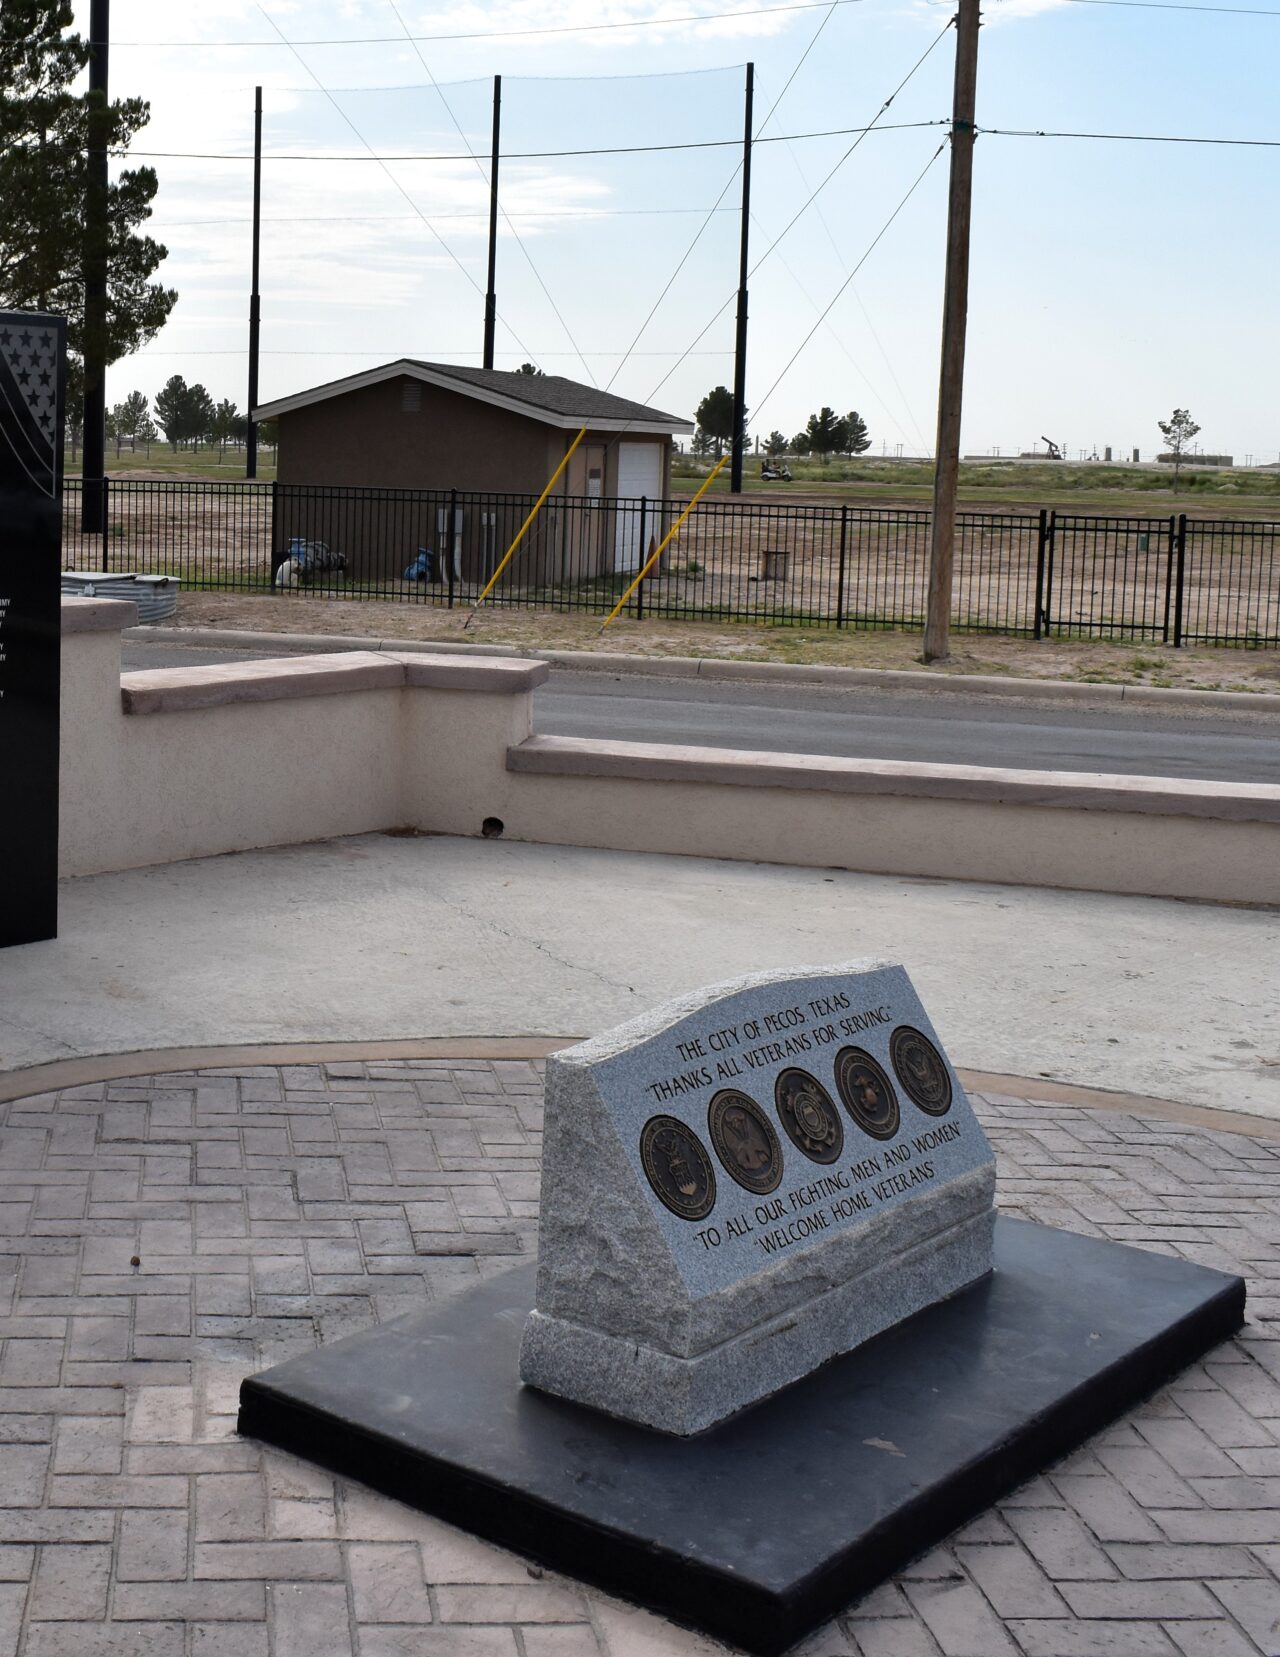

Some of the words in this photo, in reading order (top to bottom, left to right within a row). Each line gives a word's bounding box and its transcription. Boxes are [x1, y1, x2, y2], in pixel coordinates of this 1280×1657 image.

[676, 1039, 707, 1062] THE
[710, 1027, 740, 1051] CITY
[744, 1021, 763, 1039] OF
[808, 992, 850, 1018] TEXAS
[717, 1058, 743, 1080] ALL
[743, 1033, 811, 1069] VETERANS
[813, 1024, 839, 1046] FOR
[727, 1215, 753, 1240] ALL
[755, 1201, 788, 1225] OUR
[789, 1171, 850, 1211] FIGHTING
[850, 1160, 881, 1182] MEN
[885, 1144, 911, 1168] AND
[832, 1191, 872, 1222] HOME
